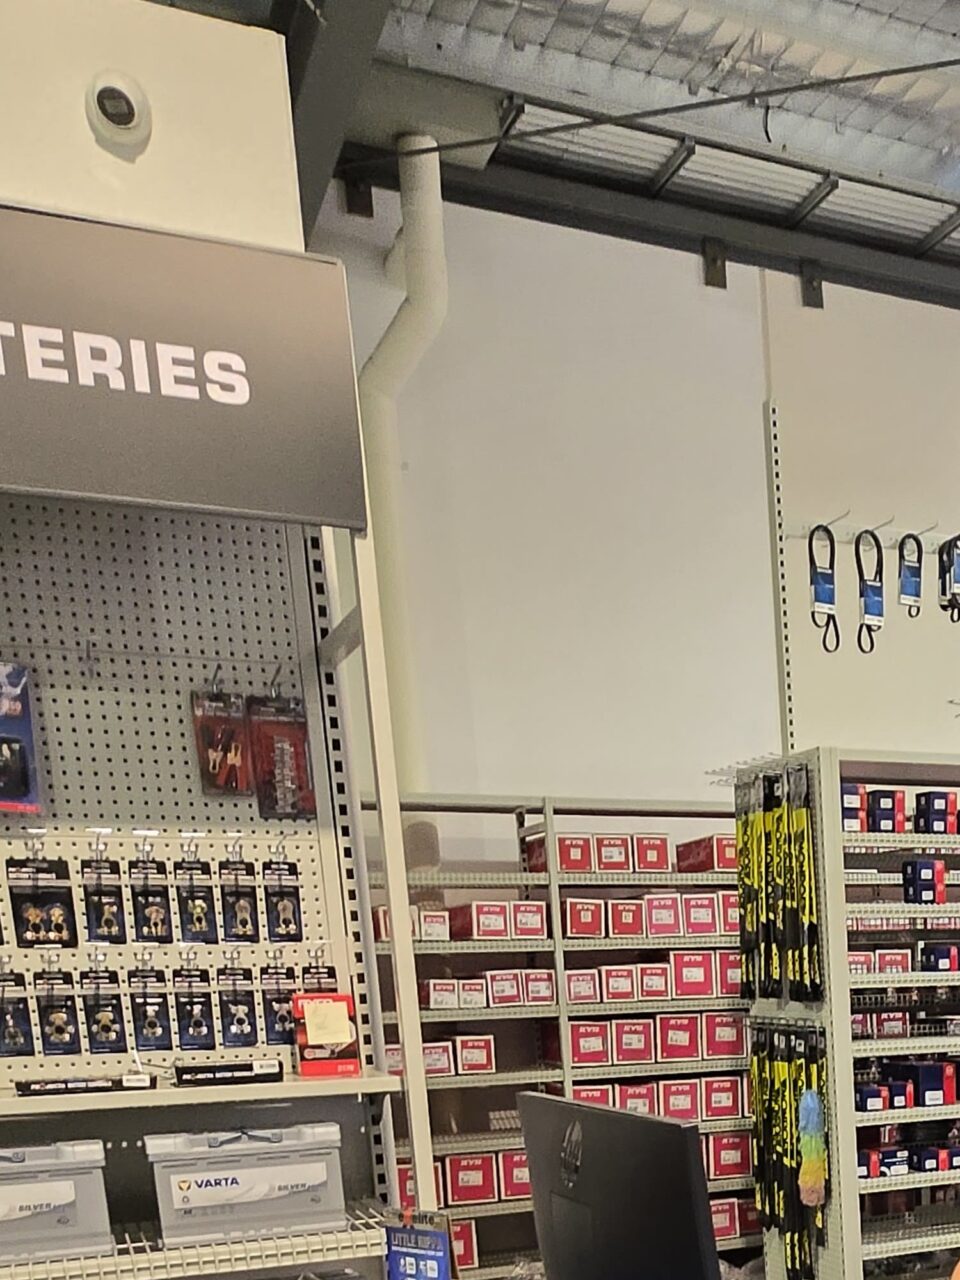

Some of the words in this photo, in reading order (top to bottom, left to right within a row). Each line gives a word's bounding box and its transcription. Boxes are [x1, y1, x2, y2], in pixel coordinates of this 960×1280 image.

[194, 1177, 240, 1189] VARTA
[278, 1183, 308, 1192] SILVER
[18, 1203, 52, 1212] SILVER
